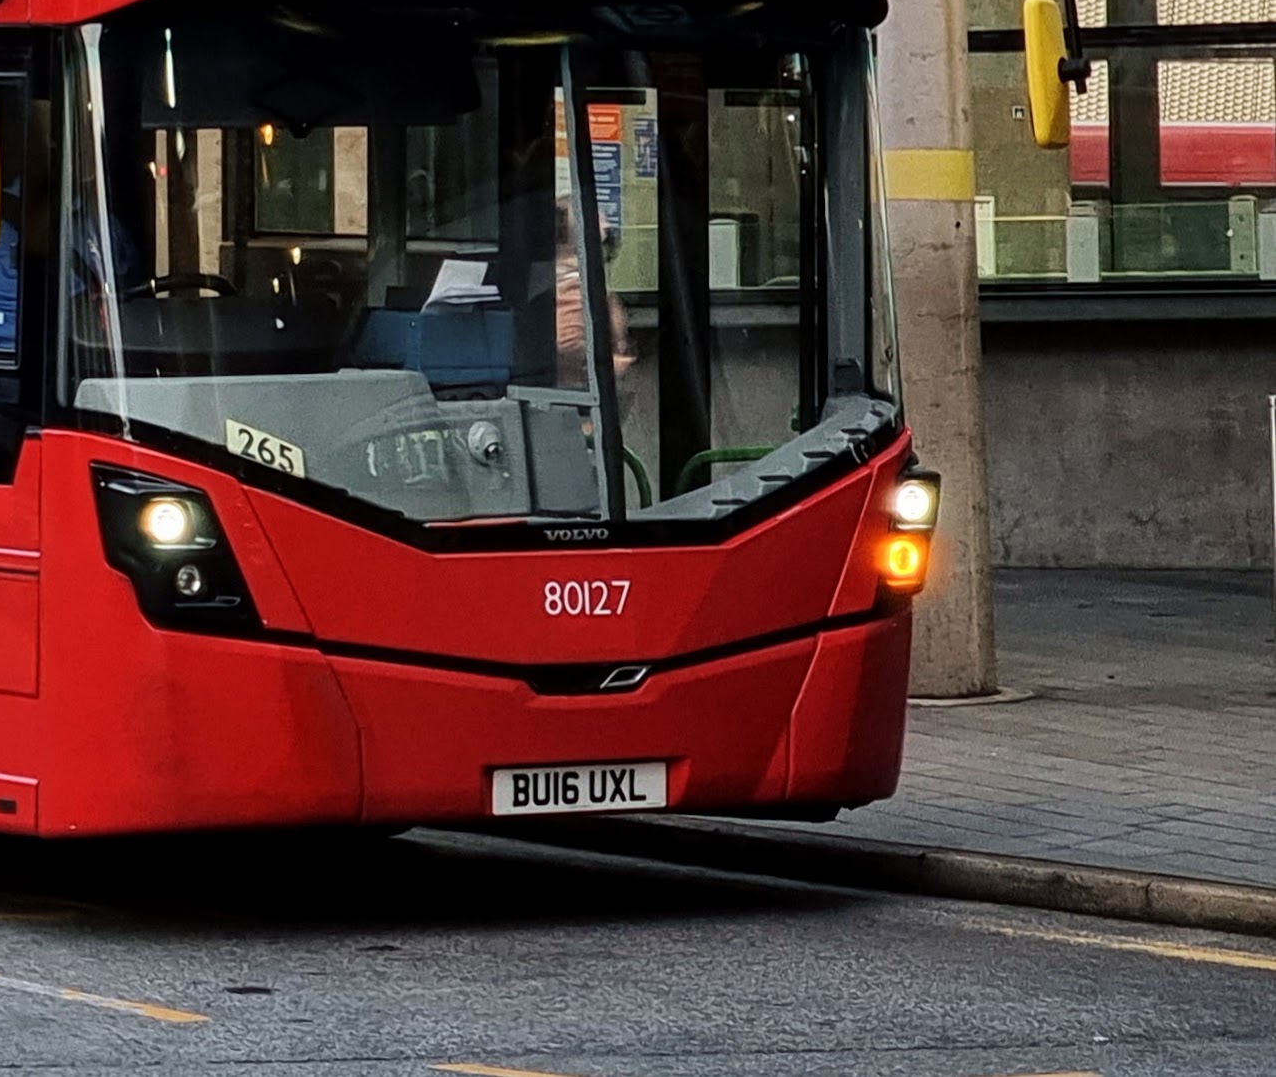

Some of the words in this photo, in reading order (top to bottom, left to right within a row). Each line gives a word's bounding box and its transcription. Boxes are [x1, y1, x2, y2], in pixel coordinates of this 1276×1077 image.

[238, 428, 294, 474] 265
[544, 528, 609, 541] VOLVO
[543, 580, 631, 615] 80127
[511, 770, 580, 808] BU16
[588, 767, 648, 804] UXL
